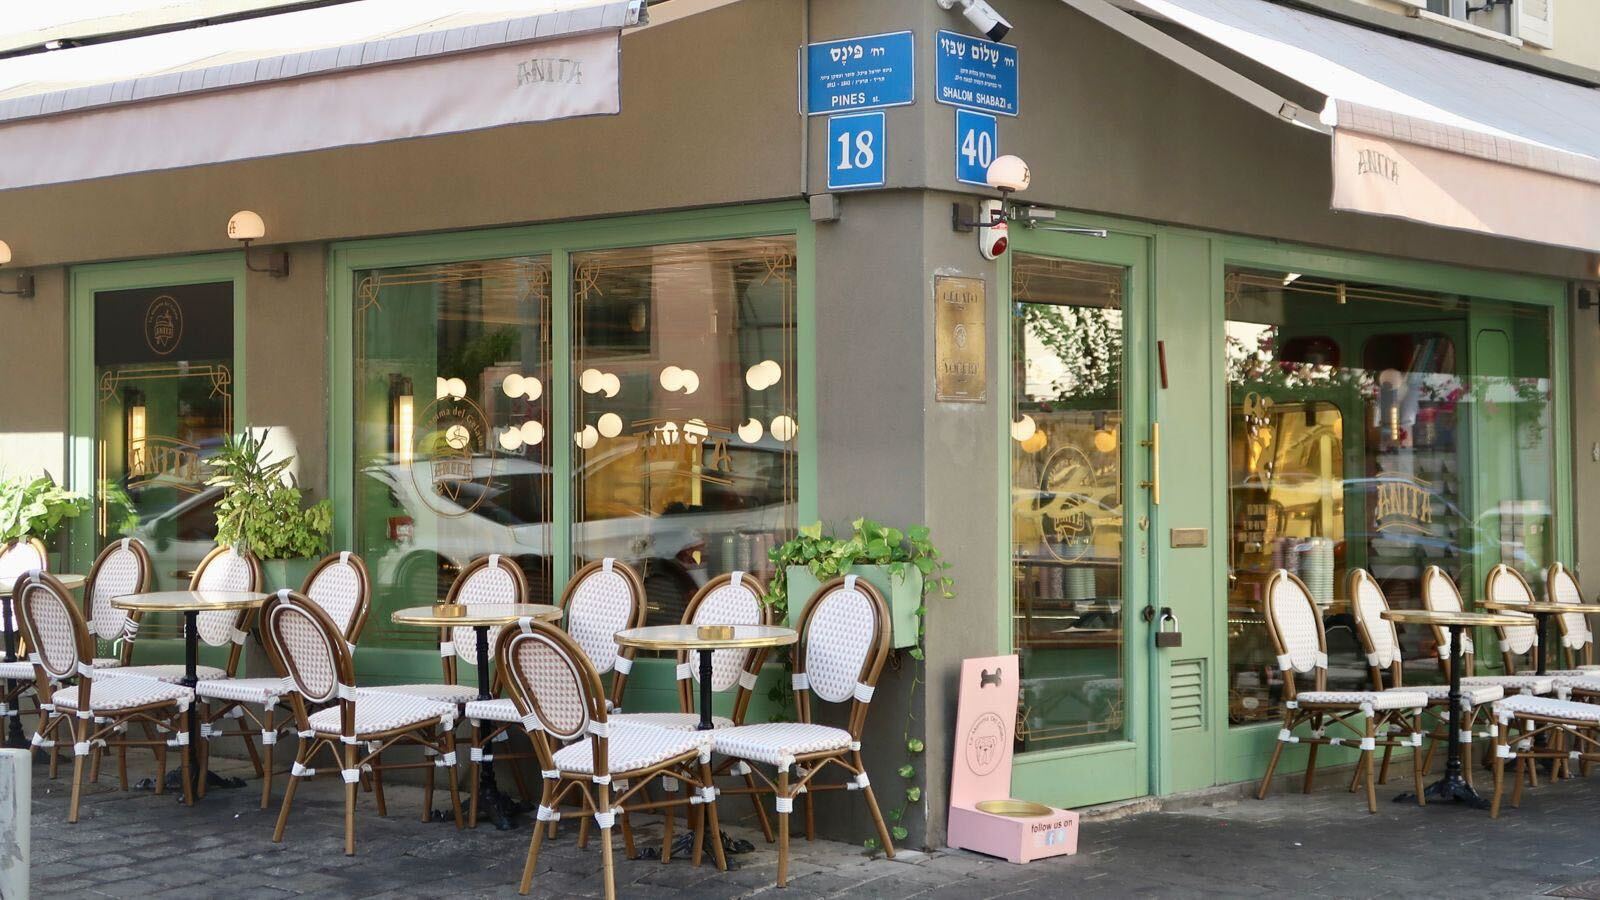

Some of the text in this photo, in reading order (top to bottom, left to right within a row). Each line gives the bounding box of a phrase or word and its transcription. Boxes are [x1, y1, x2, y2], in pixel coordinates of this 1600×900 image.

[516, 58, 584, 87] ANITA
[831, 92, 866, 107] PINES
[943, 86, 973, 102] SHALOM
[976, 93, 1006, 108] SHABAZI
[837, 130, 874, 170] 18
[962, 129, 992, 168] 40
[1357, 149, 1399, 186] ANITA
[453, 406, 466, 418] del
[466, 414, 484, 448] Gelato
[1376, 482, 1432, 523] ANITA
[1031, 819, 1073, 834] follow us on
